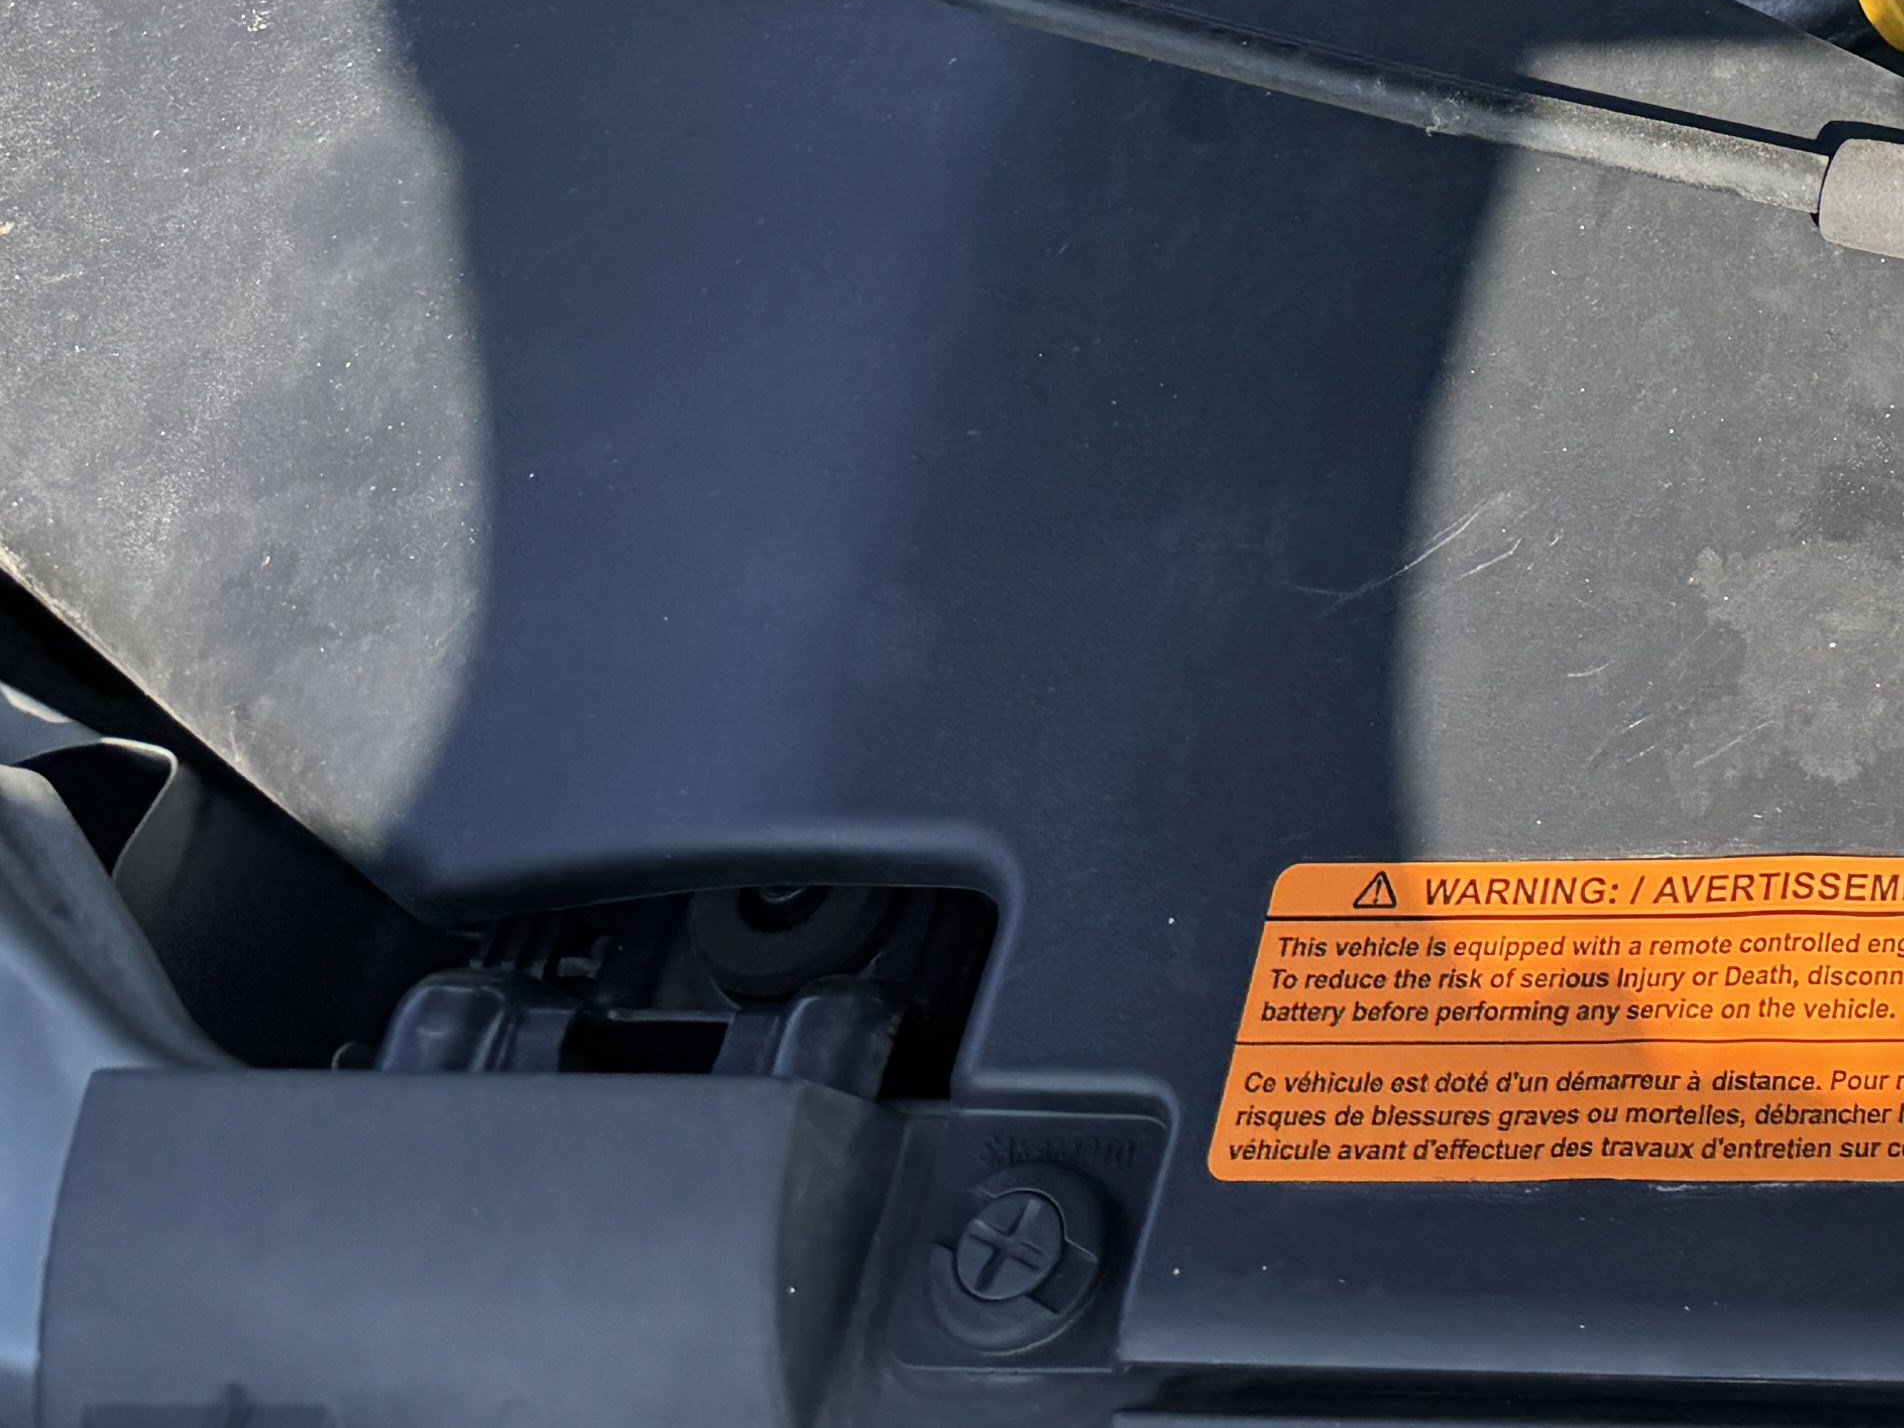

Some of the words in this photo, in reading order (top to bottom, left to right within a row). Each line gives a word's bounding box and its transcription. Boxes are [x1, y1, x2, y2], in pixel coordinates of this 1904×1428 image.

[1425, 877, 1619, 906] WARNING:
[1630, 875, 1645, 906] /
[1278, 936, 1327, 958] This
[1336, 934, 1419, 958] vehicle
[1426, 935, 1446, 957] is
[1454, 935, 1566, 962] equipped
[1572, 934, 1620, 956] with
[1629, 940, 1641, 956] a
[1649, 934, 1733, 956] remote
[1739, 931, 1861, 954] controlled
[1270, 968, 1297, 990] To
[1305, 968, 1386, 990] reduce
[1393, 968, 1431, 990] the
[1438, 967, 1482, 989] risk
[1490, 966, 1515, 988] of
[1520, 966, 1609, 988] serious
[1692, 969, 1719, 987] or
[1724, 965, 1800, 990] Death,
[1261, 1001, 1346, 1027] battery
[1352, 1000, 1428, 1023] before
[1434, 999, 1569, 1027] performing
[1576, 1005, 1620, 1026] any
[1626, 998, 1714, 1020] service
[1721, 1001, 1751, 1019] on
[1757, 997, 1796, 1019] the
[1804, 996, 1896, 1019] vehicle.
[1244, 1071, 1276, 1094] Ce
[1283, 1070, 1383, 1094] véhicule
[1390, 1074, 1428, 1093] est
[1434, 1070, 1488, 1093] doté
[1496, 1070, 1548, 1093] d'un
[1556, 1070, 1680, 1093] démarreur
[1686, 1070, 1701, 1092] à
[1712, 1069, 1822, 1091] distance.
[1830, 1069, 1889, 1091] Pour
[1235, 1105, 1326, 1131] risques
[1334, 1105, 1364, 1127] de
[1371, 1104, 1491, 1127] blessures
[1498, 1107, 1579, 1131] graves
[1587, 1106, 1618, 1125] ou
[1625, 1103, 1746, 1129] mortelles,
[1755, 1102, 1893, 1126] débrancher
[1229, 1137, 1331, 1162] véhicule
[1336, 1140, 1406, 1162] avant
[1413, 1137, 1545, 1162] d'effectuer
[1551, 1136, 1593, 1159] des
[1601, 1138, 1694, 1159] travaux
[1702, 1136, 1832, 1160] d'entretien
[1839, 1140, 1881, 1158] sur
